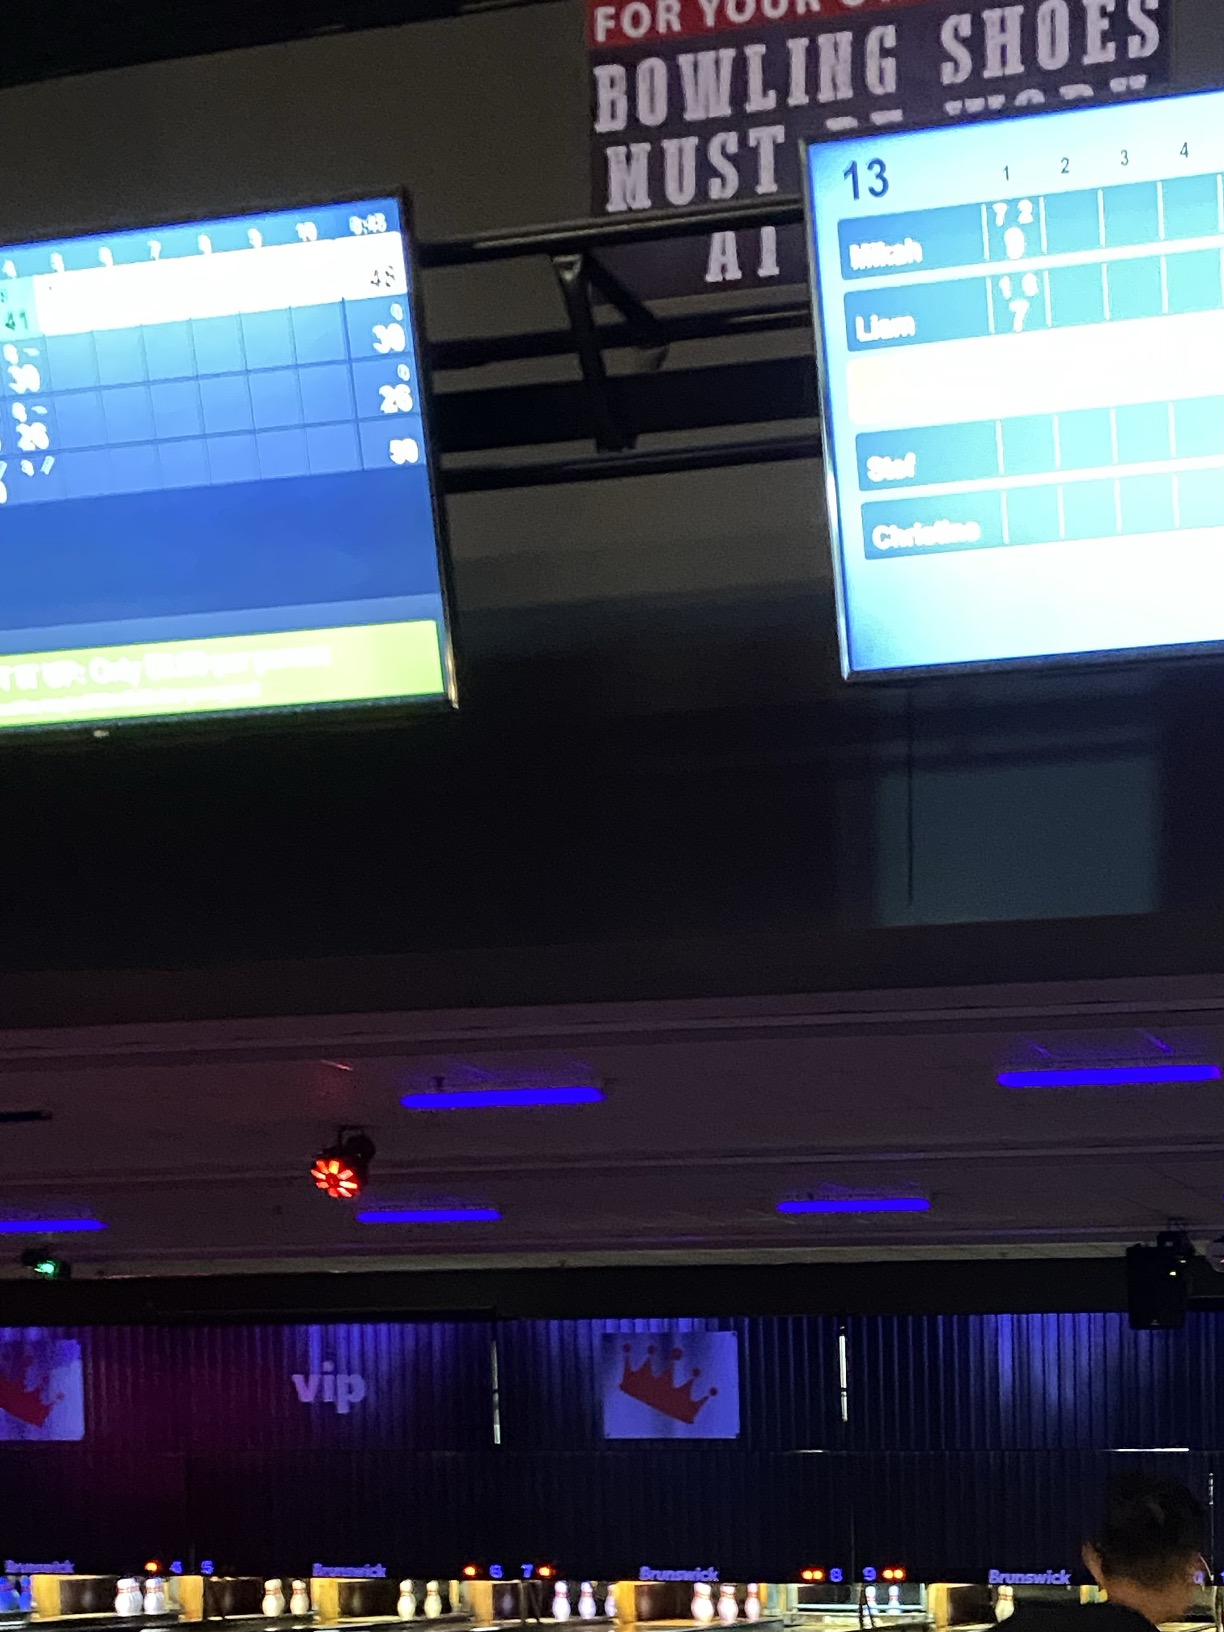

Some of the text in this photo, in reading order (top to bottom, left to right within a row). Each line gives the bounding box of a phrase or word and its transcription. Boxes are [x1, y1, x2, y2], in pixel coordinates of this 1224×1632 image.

[594, 0, 682, 42] FOR
[593, 24, 898, 133] BOWLING
[940, 0, 1160, 86] SHOES
[605, 125, 785, 212] MUST
[843, 157, 889, 201] 13
[1003, 165, 1009, 181] 1
[1060, 157, 1070, 174] 2
[1120, 149, 1129, 166] 3
[1179, 142, 1189, 158] 4
[992, 202, 1008, 227] 7
[1008, 299, 1030, 333] 7
[292, 1361, 366, 1414] vip
[988, 1569, 1072, 1585] Brunswick
